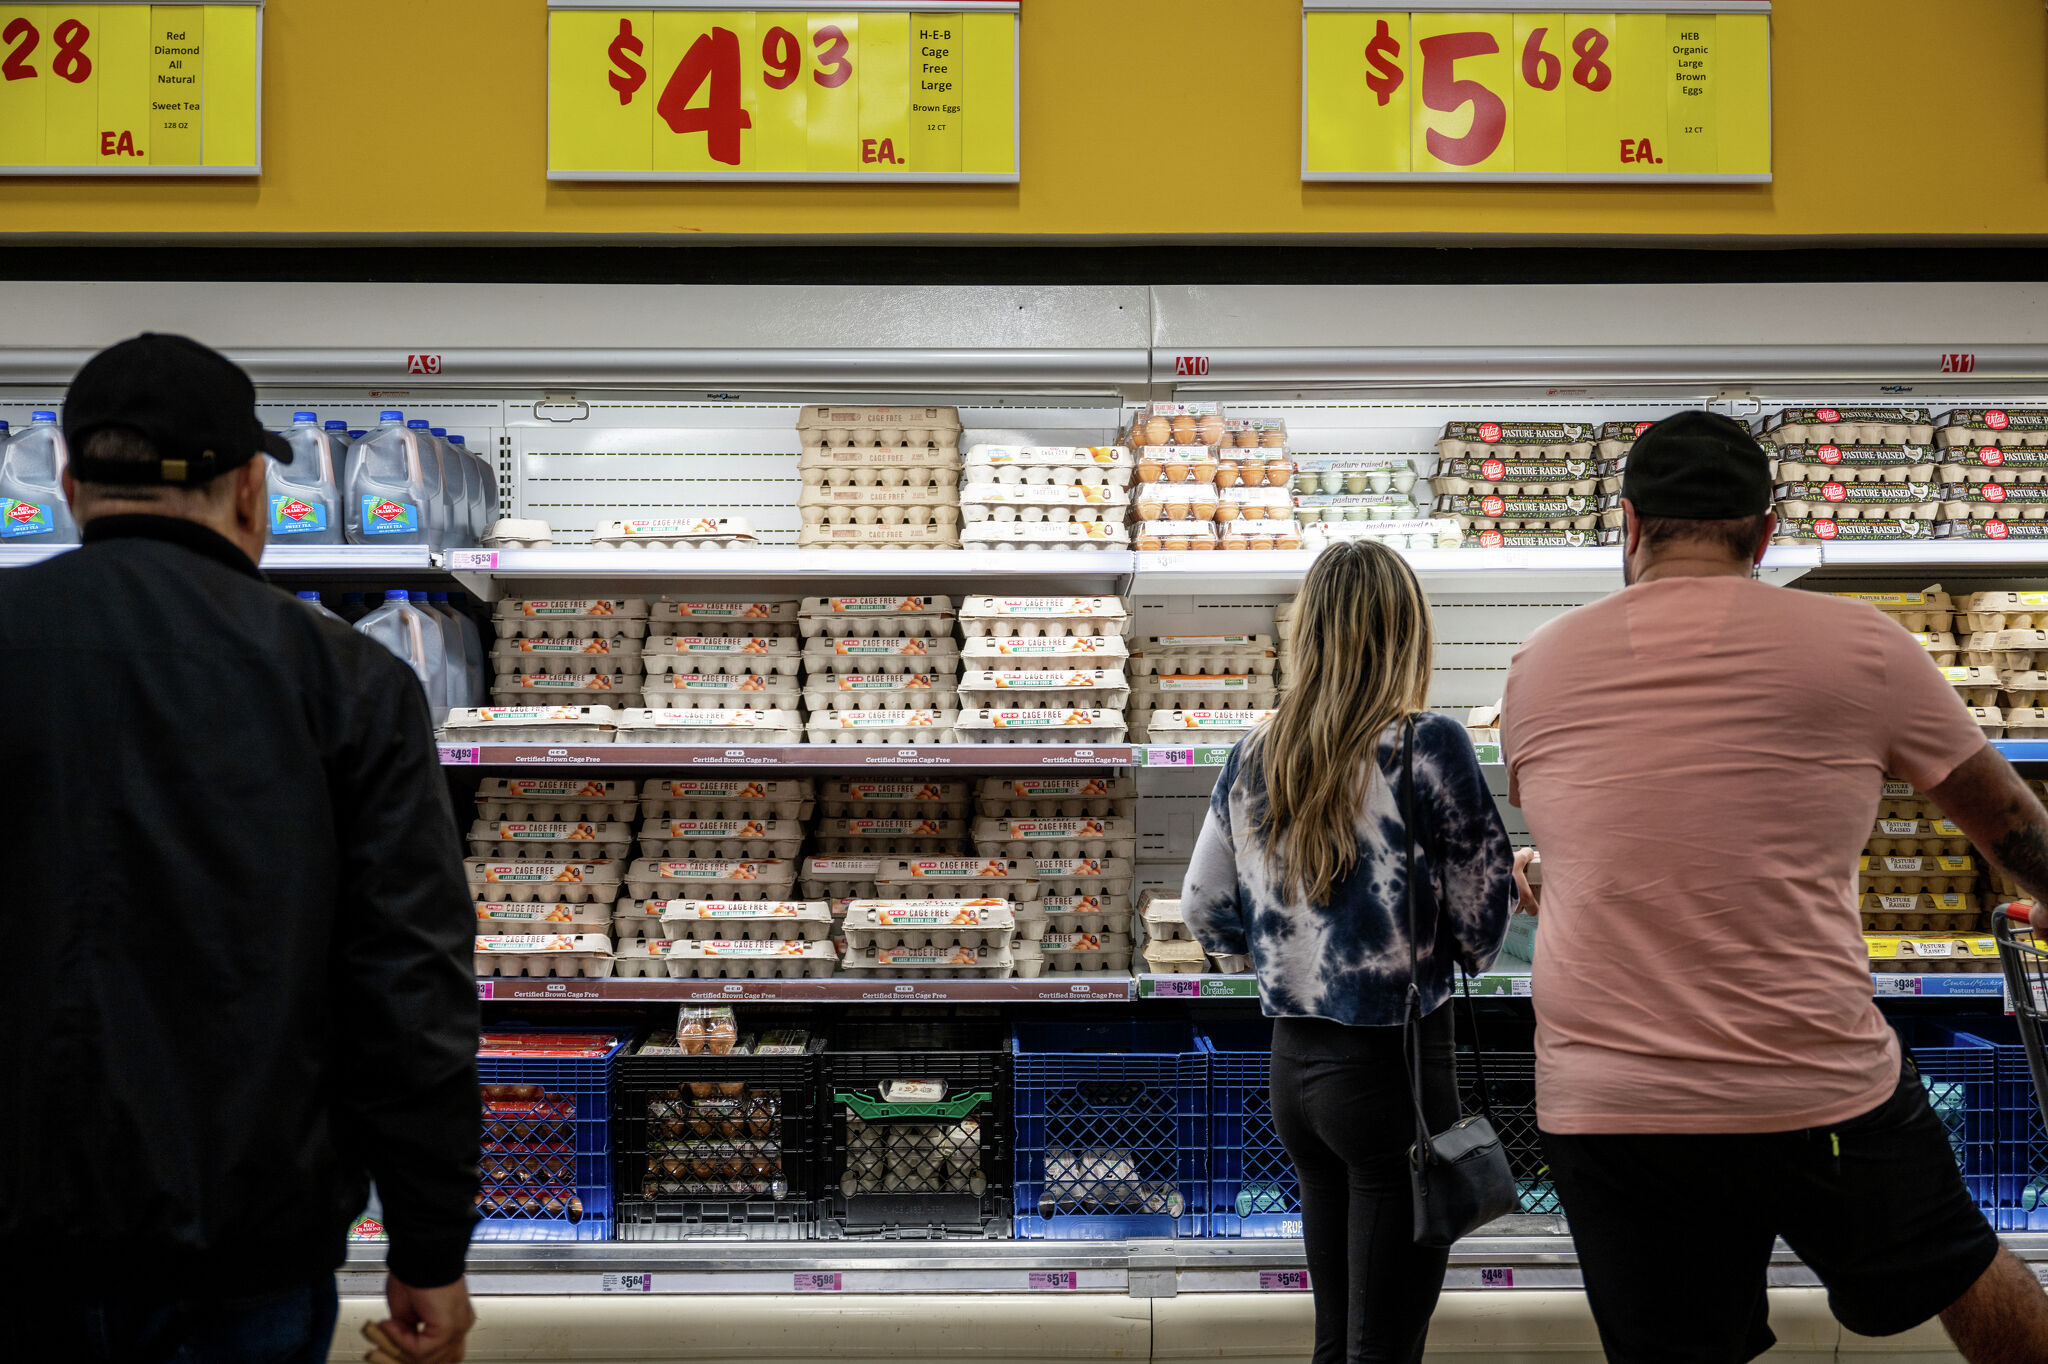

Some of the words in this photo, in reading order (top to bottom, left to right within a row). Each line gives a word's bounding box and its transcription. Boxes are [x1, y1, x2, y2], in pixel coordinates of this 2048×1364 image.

[166, 31, 186, 41] Red
[919, 29, 952, 40] H-E-B
[1680, 32, 1700, 41] HEB
[154, 45, 200, 55] Diamond
[921, 46, 949, 59] Cage
[1672, 45, 1709, 57] Organic
[168, 60, 182, 69] All
[922, 63, 948, 74] Free
[1678, 59, 1704, 70] Large
[157, 74, 195, 84] Natural
[1675, 73, 1707, 82] Brown
[920, 79, 952, 93] Large
[1682, 86, 1703, 97] Eggs
[152, 101, 181, 111] Sweet
[183, 101, 200, 111] Tea
[912, 103, 939, 113] Brown
[941, 103, 961, 115] Eggs
[163, 121, 177, 129] 128
[178, 121, 189, 129] OZ
[927, 123, 935, 131] 12
[936, 123, 946, 131] CT
[1684, 126, 1693, 134] 12
[1694, 126, 1703, 134] CT
[100, 130, 144, 157] EA.
[861, 137, 905, 165] EA.
[1619, 138, 1664, 164] EA.
[408, 354, 441, 374] A9
[1176, 356, 1209, 376] A10
[1940, 353, 1975, 373] A11
[1840, 411, 1903, 420] PASTURE-RAISED
[1502, 429, 1565, 439] PASTURE-RAISED
[1842, 451, 1906, 460] PASTURE-RAISED
[1505, 466, 1568, 476] PASTURE-RAISED
[1847, 488, 1910, 498] PASTURE-RAISED
[1505, 502, 1568, 512] PASTURE-RAISED
[1838, 525, 1902, 534] PASTURE-RAISED
[1504, 537, 1567, 547] PASTURE-RAISED
[723, 638, 742, 646] FREE
[862, 639, 880, 647] CAGE
[882, 639, 900, 647] FREE
[866, 675, 884, 683] CAGE
[886, 675, 904, 683] FREE
[1022, 711, 1041, 719] CAGE
[1043, 711, 1062, 719] FREE
[451, 748, 472, 761] $493
[1165, 750, 1186, 763] $618
[1204, 752, 1229, 766] Organi
[568, 756, 584, 764] Cage
[745, 757, 761, 765] Cage
[918, 757, 934, 765] Cage
[1095, 757, 1111, 765] Cage
[529, 824, 548, 832] CAGE
[549, 824, 567, 832] FREE
[700, 821, 718, 830] CAGE
[719, 821, 737, 829] FREE
[1886, 820, 1912, 828] PASTURE
[515, 866, 534, 874] CAGE
[536, 866, 554, 874] FREE
[940, 861, 959, 870] CAGE
[960, 861, 979, 869] FREE
[909, 909, 928, 917] CAGE
[930, 909, 949, 917] FREE
[1920, 942, 1946, 950] PASTURE
[1172, 981, 1193, 994] $628
[1894, 978, 1915, 991] $938
[1202, 984, 1234, 996] Organics
[1091, 992, 1108, 1000] Cage
[1282, 1220, 1303, 1234] PROP
[812, 1274, 834, 1287] $598
[1047, 1273, 1069, 1286] $512
[1277, 1272, 1300, 1286] $562
[1481, 1269, 1503, 1282] $448
[621, 1275, 643, 1288] $564
